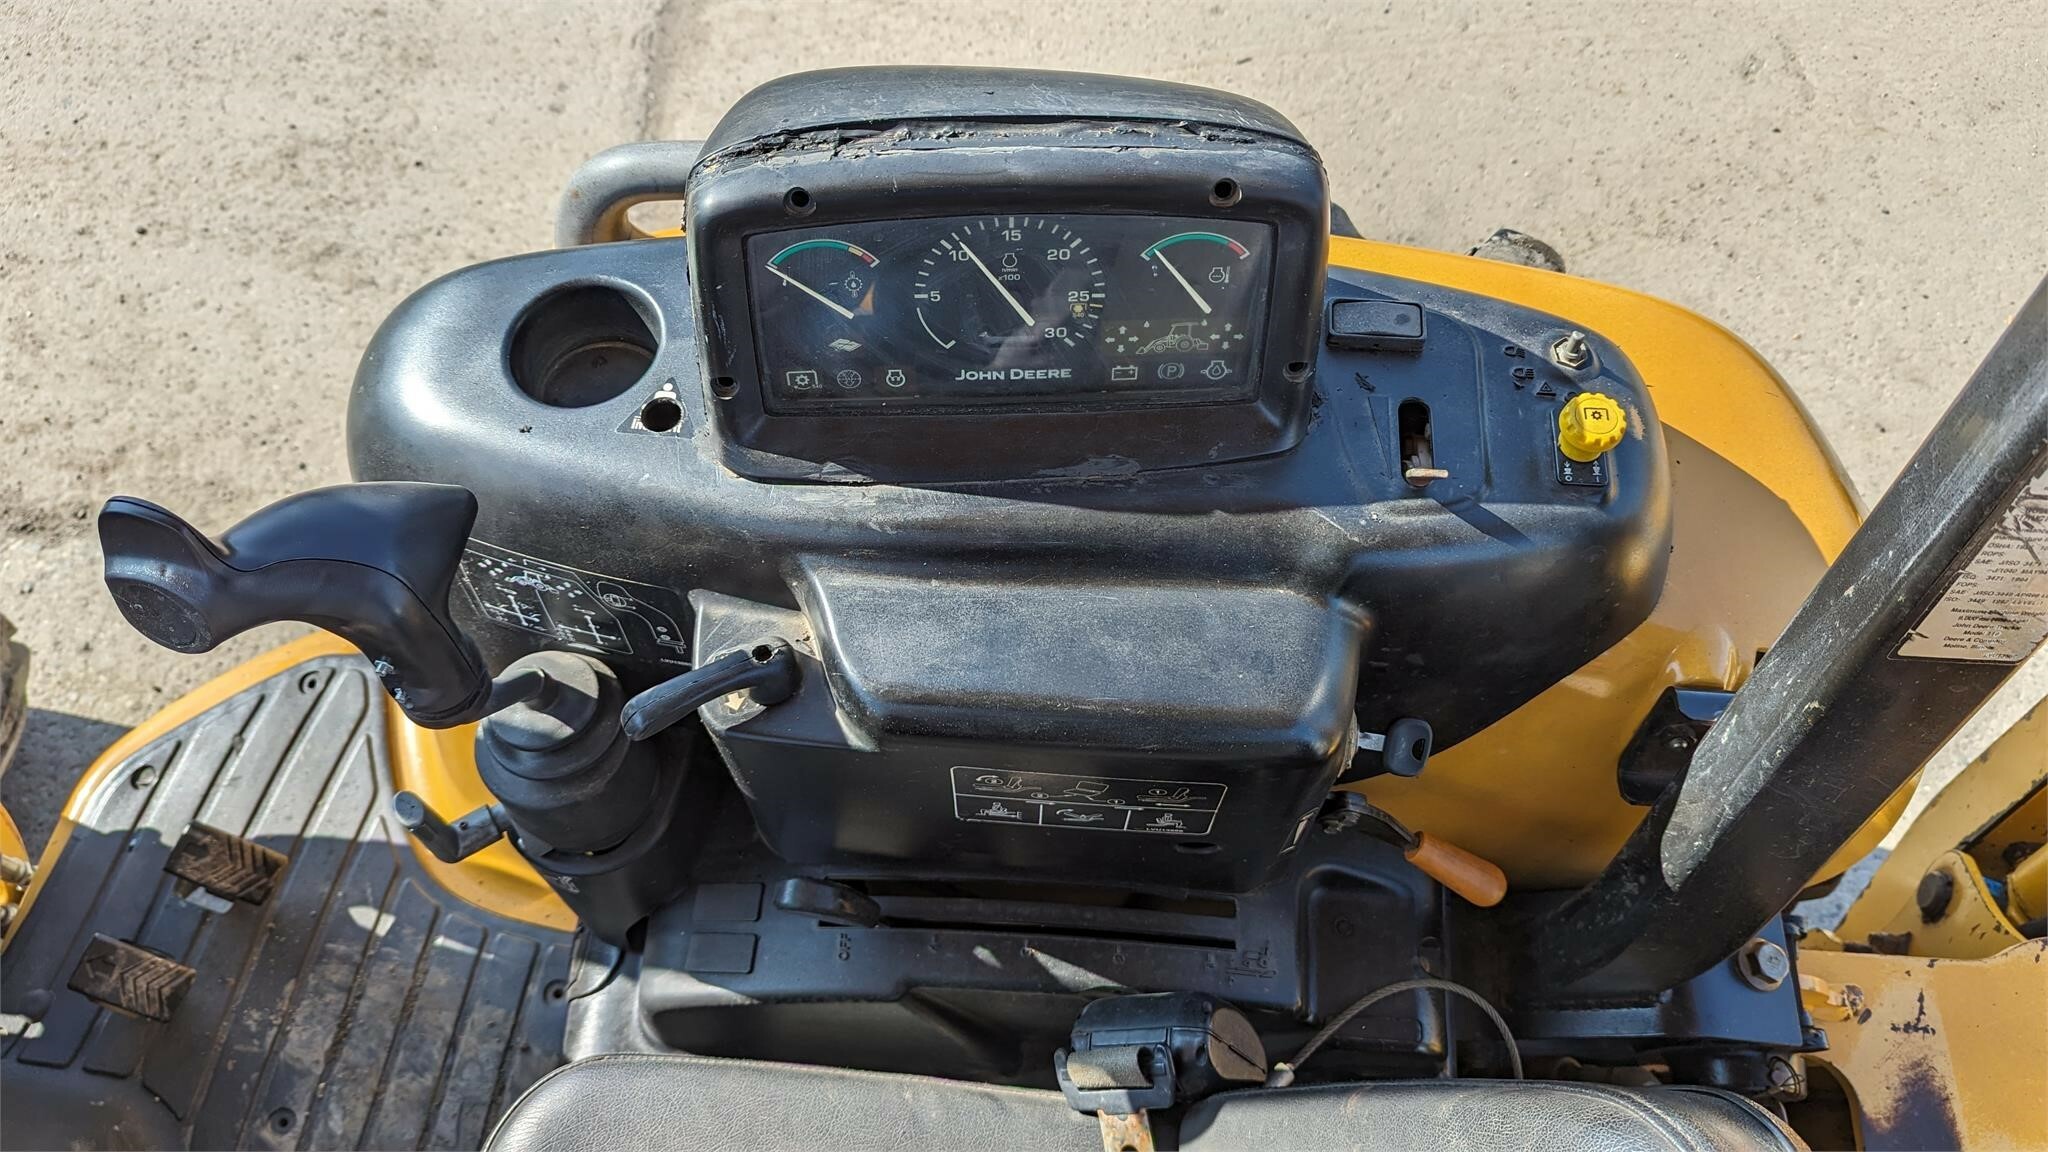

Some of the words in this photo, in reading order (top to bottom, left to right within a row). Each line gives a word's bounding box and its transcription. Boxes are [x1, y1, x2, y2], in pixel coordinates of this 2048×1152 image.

[1001, 229, 1022, 241] 15
[948, 249, 969, 261] 10
[1047, 249, 1070, 261] 20
[930, 290, 941, 302] 5
[1068, 290, 1090, 302] 25
[1044, 327, 1067, 339] 30
[955, 369, 1005, 381] JOHN
[1008, 368, 1072, 380] DEERE
